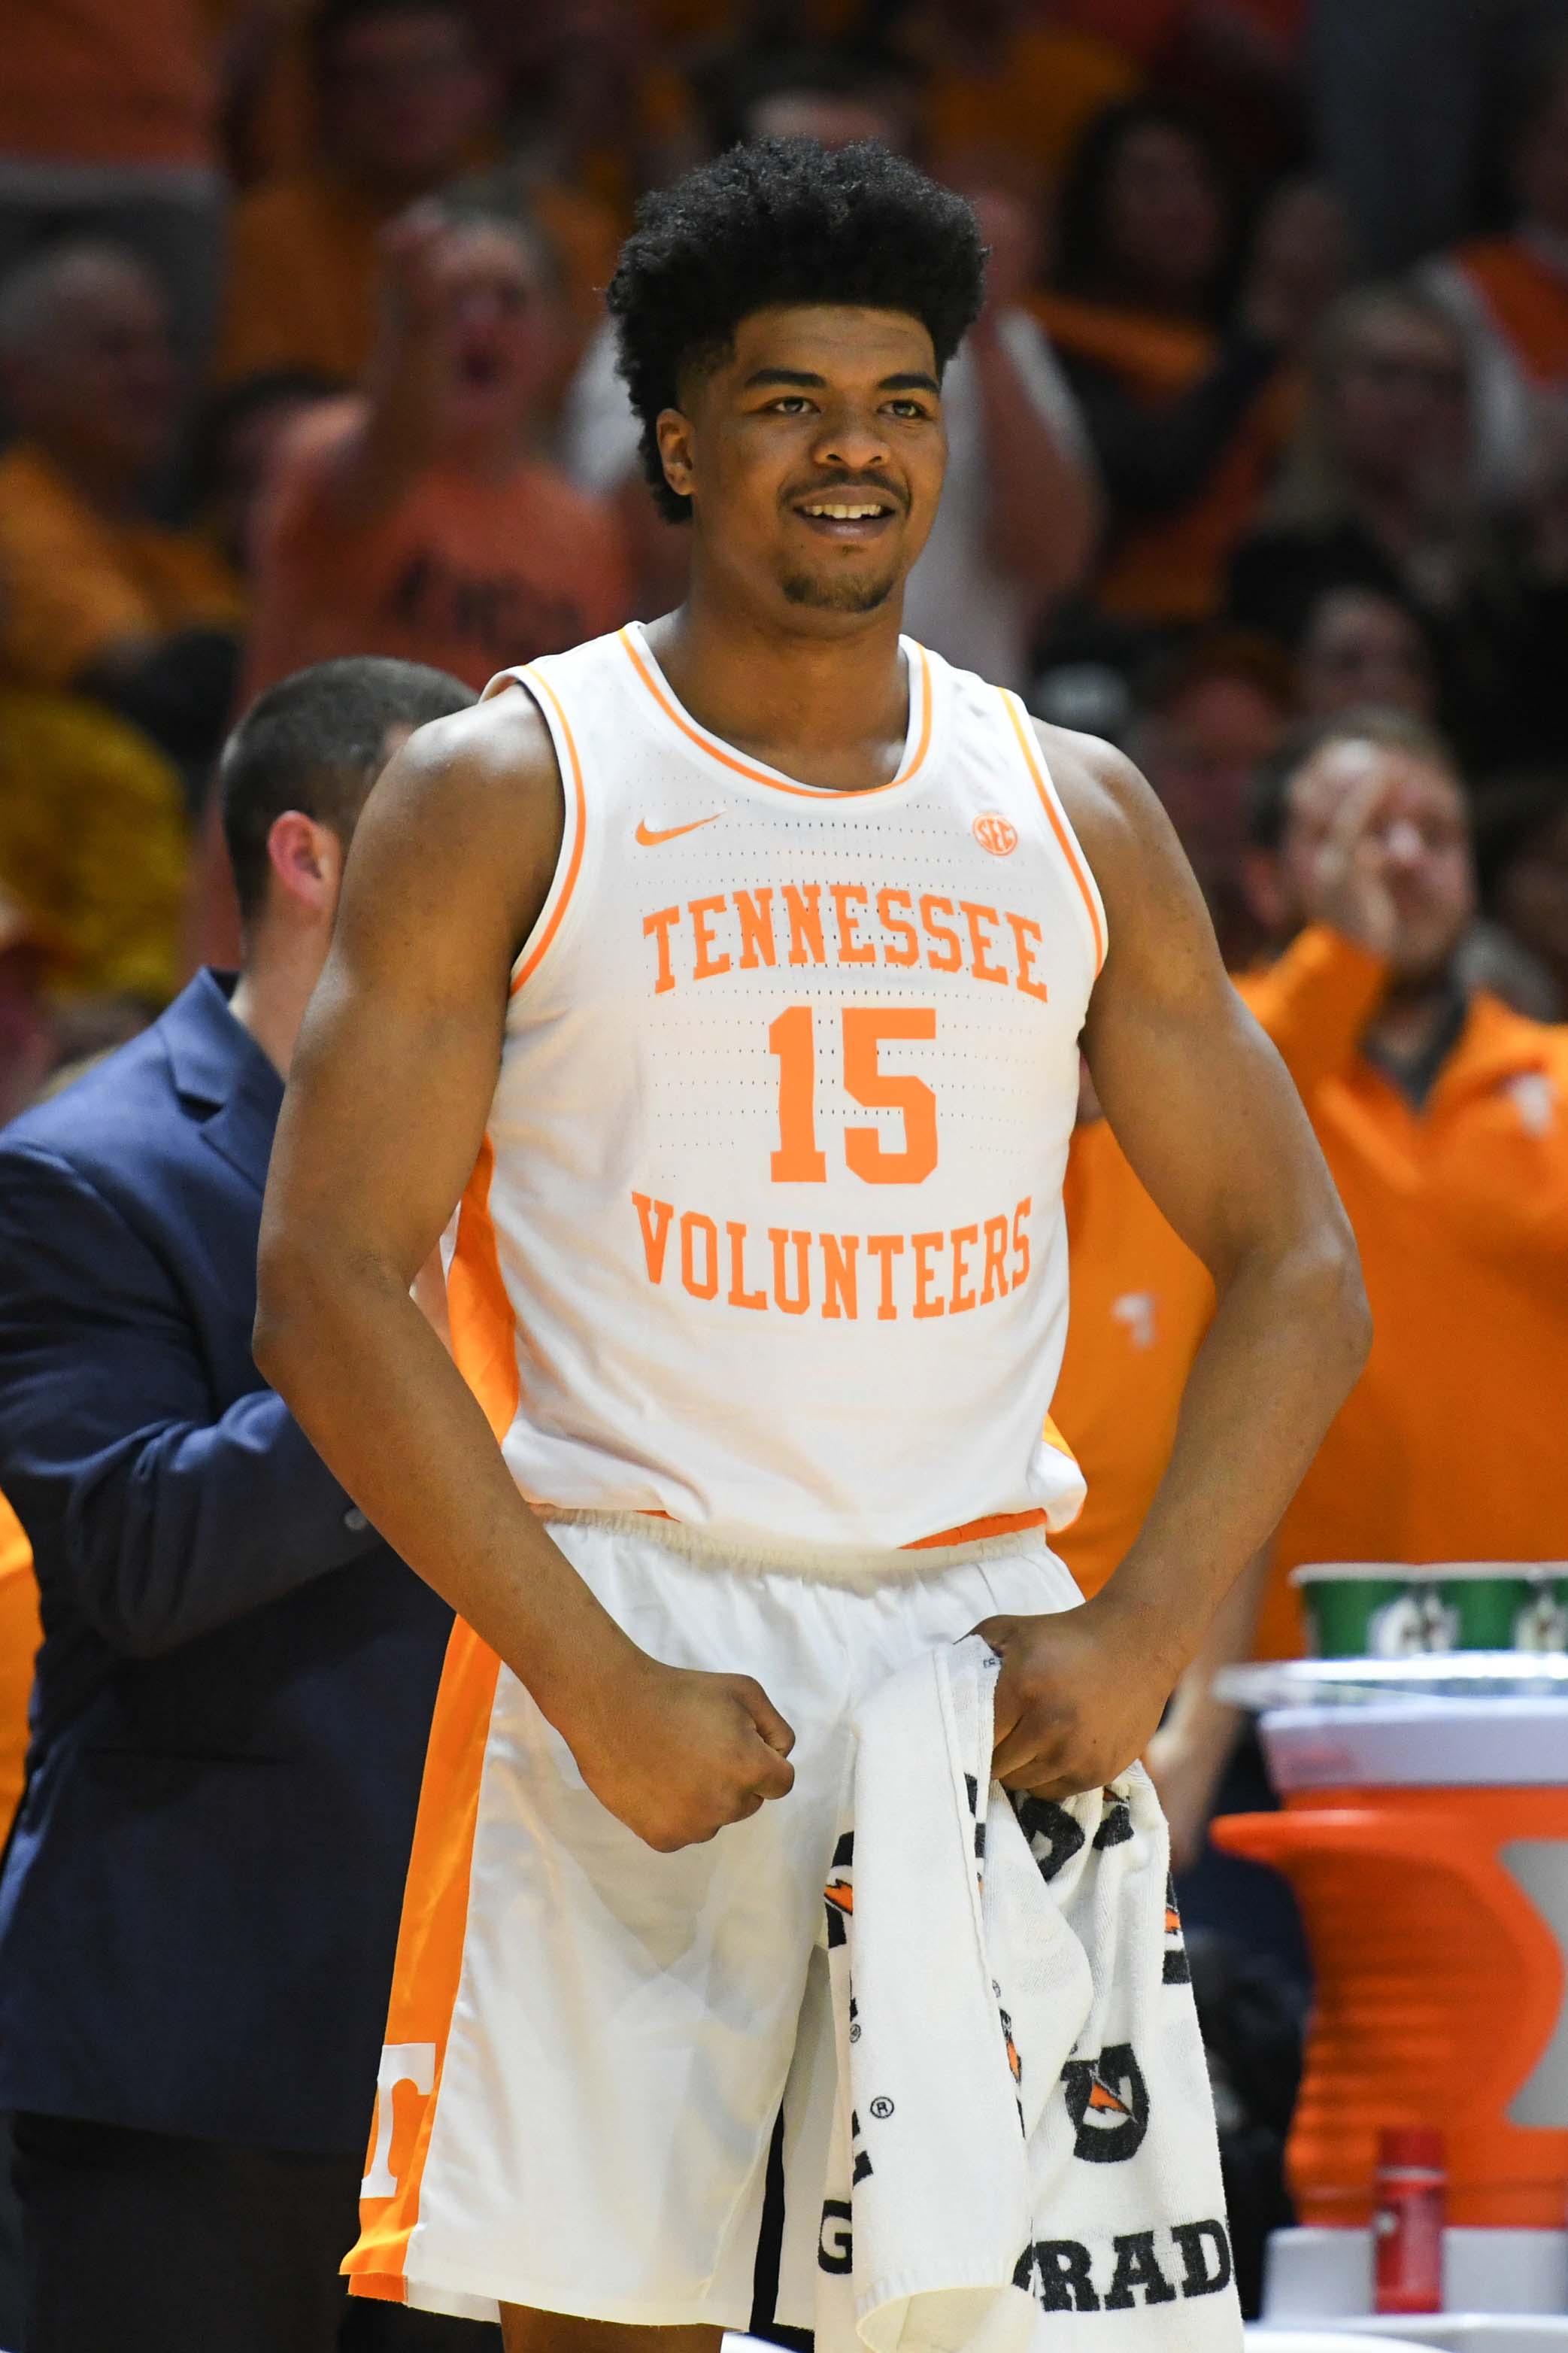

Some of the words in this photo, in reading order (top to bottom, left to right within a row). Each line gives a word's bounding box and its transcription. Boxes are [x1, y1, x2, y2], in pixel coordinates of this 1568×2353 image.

[643, 884, 1048, 1003] TENNESSEE
[769, 1005, 939, 1185] 15
[632, 1192, 1032, 1320] VOLUNTEERS
[1012, 2218, 1231, 2312] RAD
